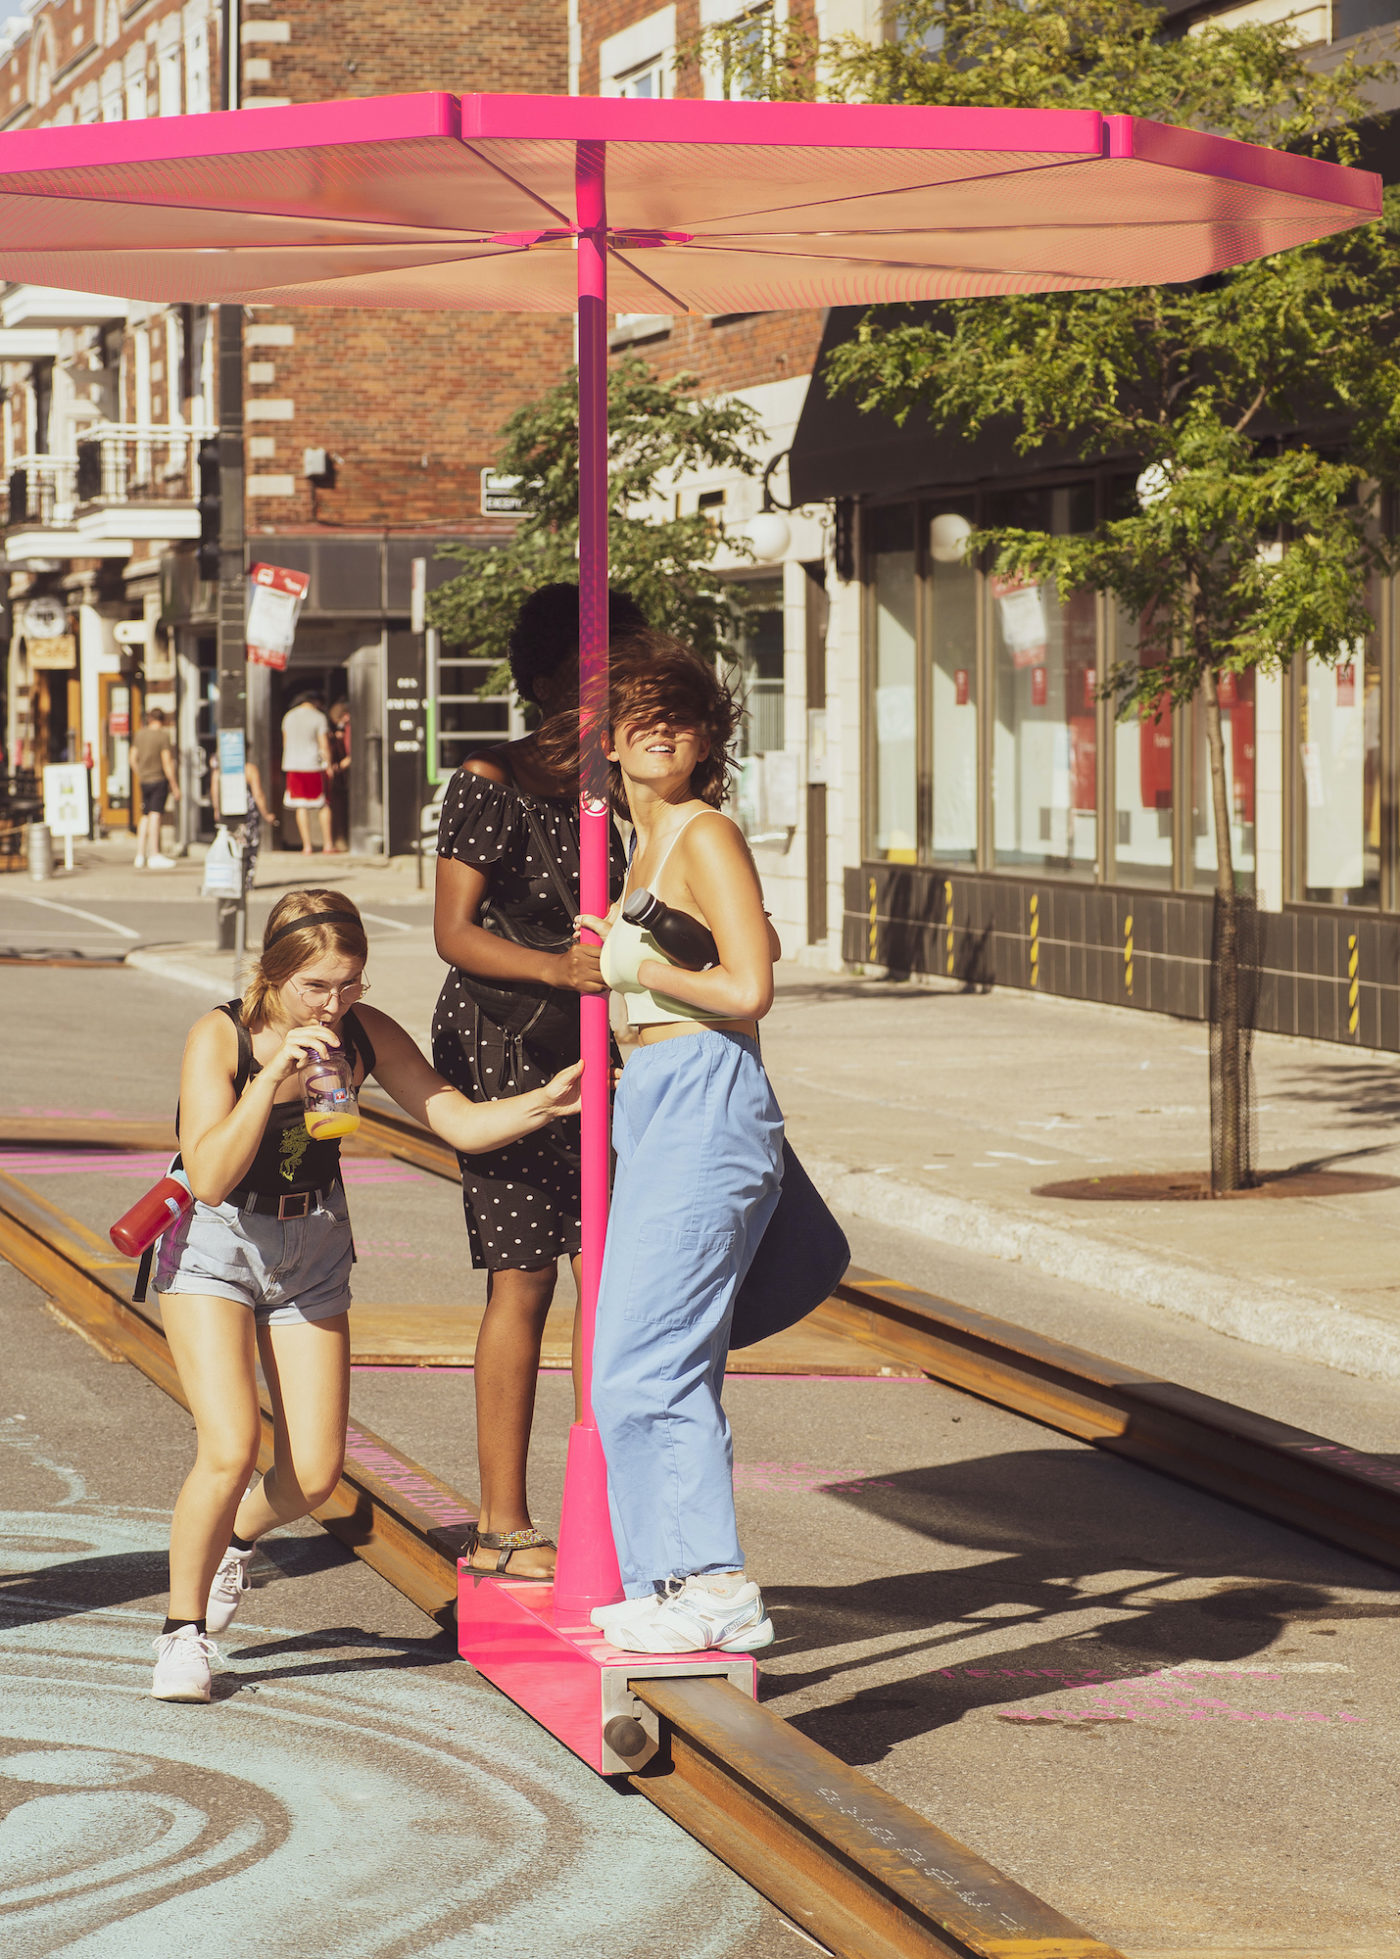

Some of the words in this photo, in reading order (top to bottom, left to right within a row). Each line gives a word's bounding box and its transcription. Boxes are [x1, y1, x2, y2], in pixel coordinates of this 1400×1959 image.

[381, 1476, 436, 1492] SUR
[402, 1492, 459, 1508] LES
[931, 1668, 1280, 1680] TENEZ-VOUS
[1062, 1680, 1197, 1690] BIEN
